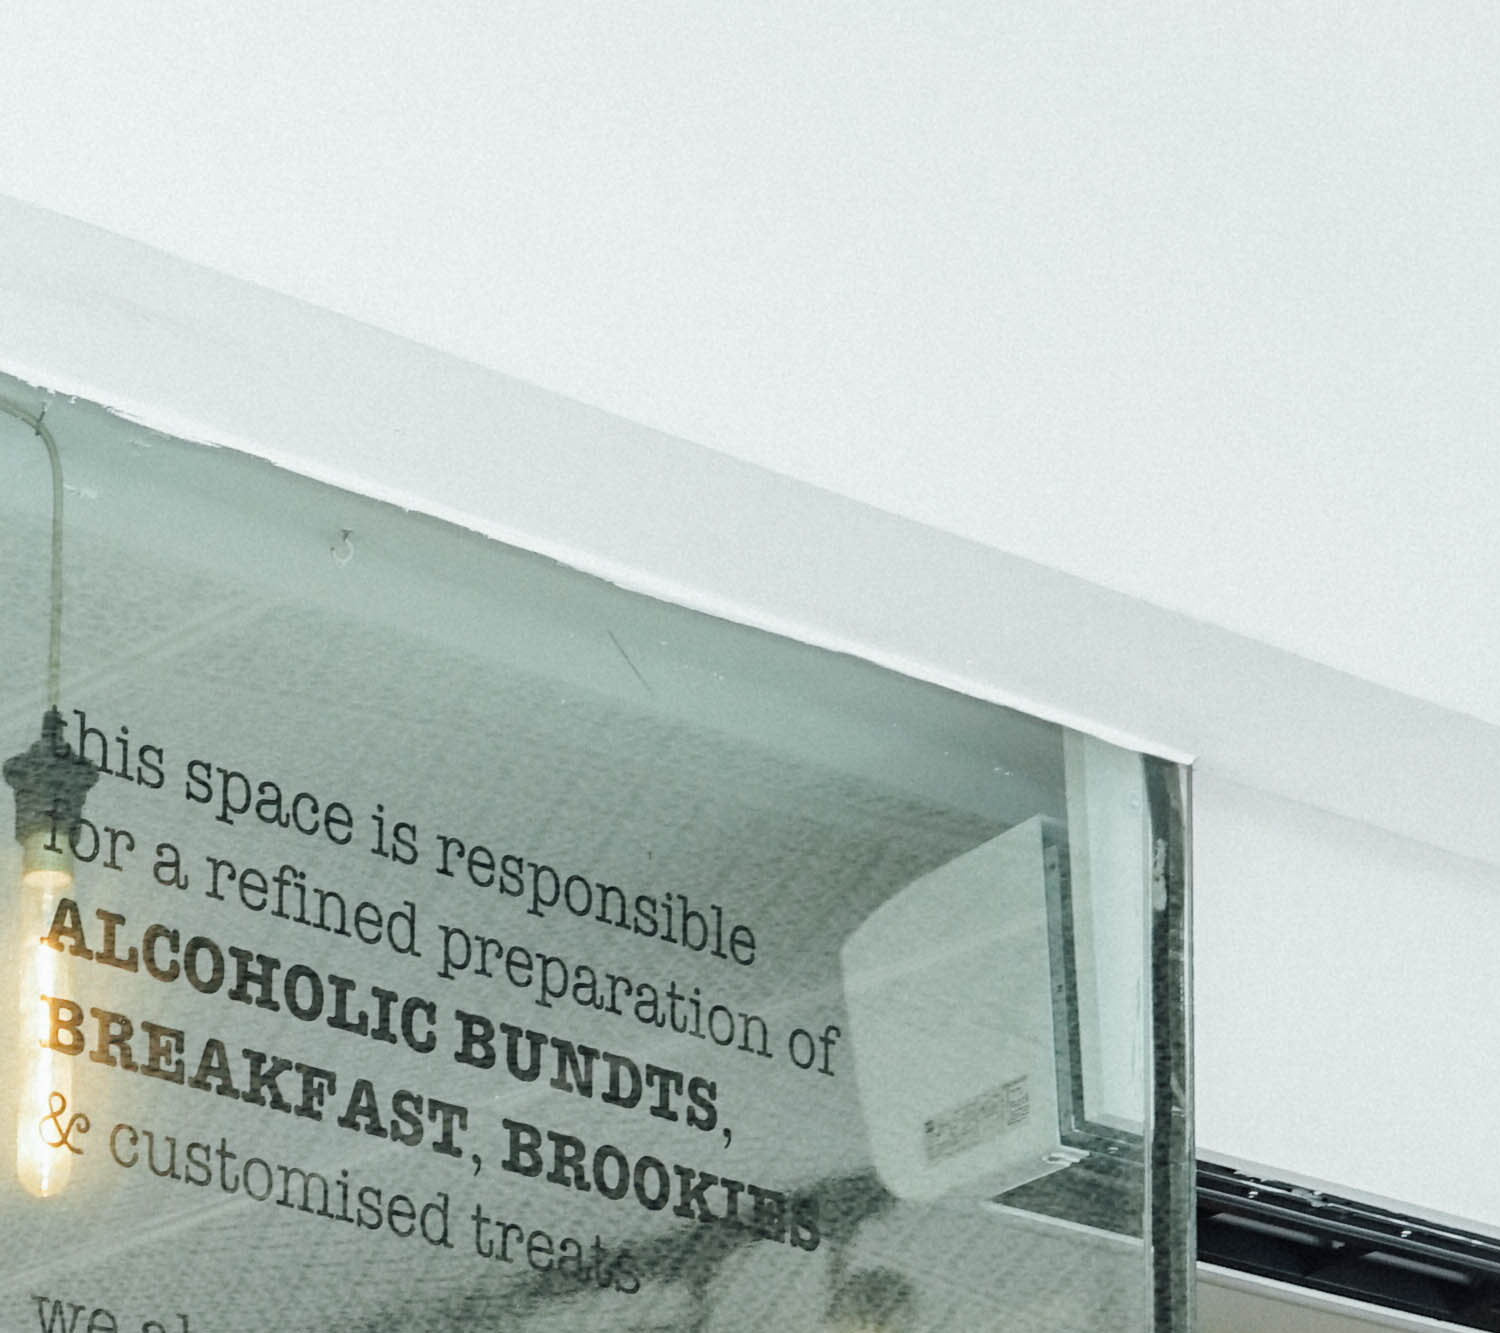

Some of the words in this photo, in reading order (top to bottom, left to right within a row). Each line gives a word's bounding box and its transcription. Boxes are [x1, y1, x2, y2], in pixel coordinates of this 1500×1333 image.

[42, 796, 136, 874] for
[151, 844, 188, 894] a
[205, 852, 422, 960] refined
[437, 922, 772, 1060] preparation
[788, 1023, 841, 1078] of
[50, 706, 166, 790] this
[185, 756, 355, 846] space
[370, 805, 420, 867] is
[434, 831, 759, 967] responsible
[39, 995, 484, 1176] BREAKFAST,
[500, 1118, 822, 1254] BROOKIES
[40, 898, 439, 1055] ALCOHOLIC
[455, 1009, 735, 1147] BUNDTS,
[38, 1091, 91, 1156] &
[108, 1120, 455, 1250] customised
[473, 1205, 644, 1297] treats
